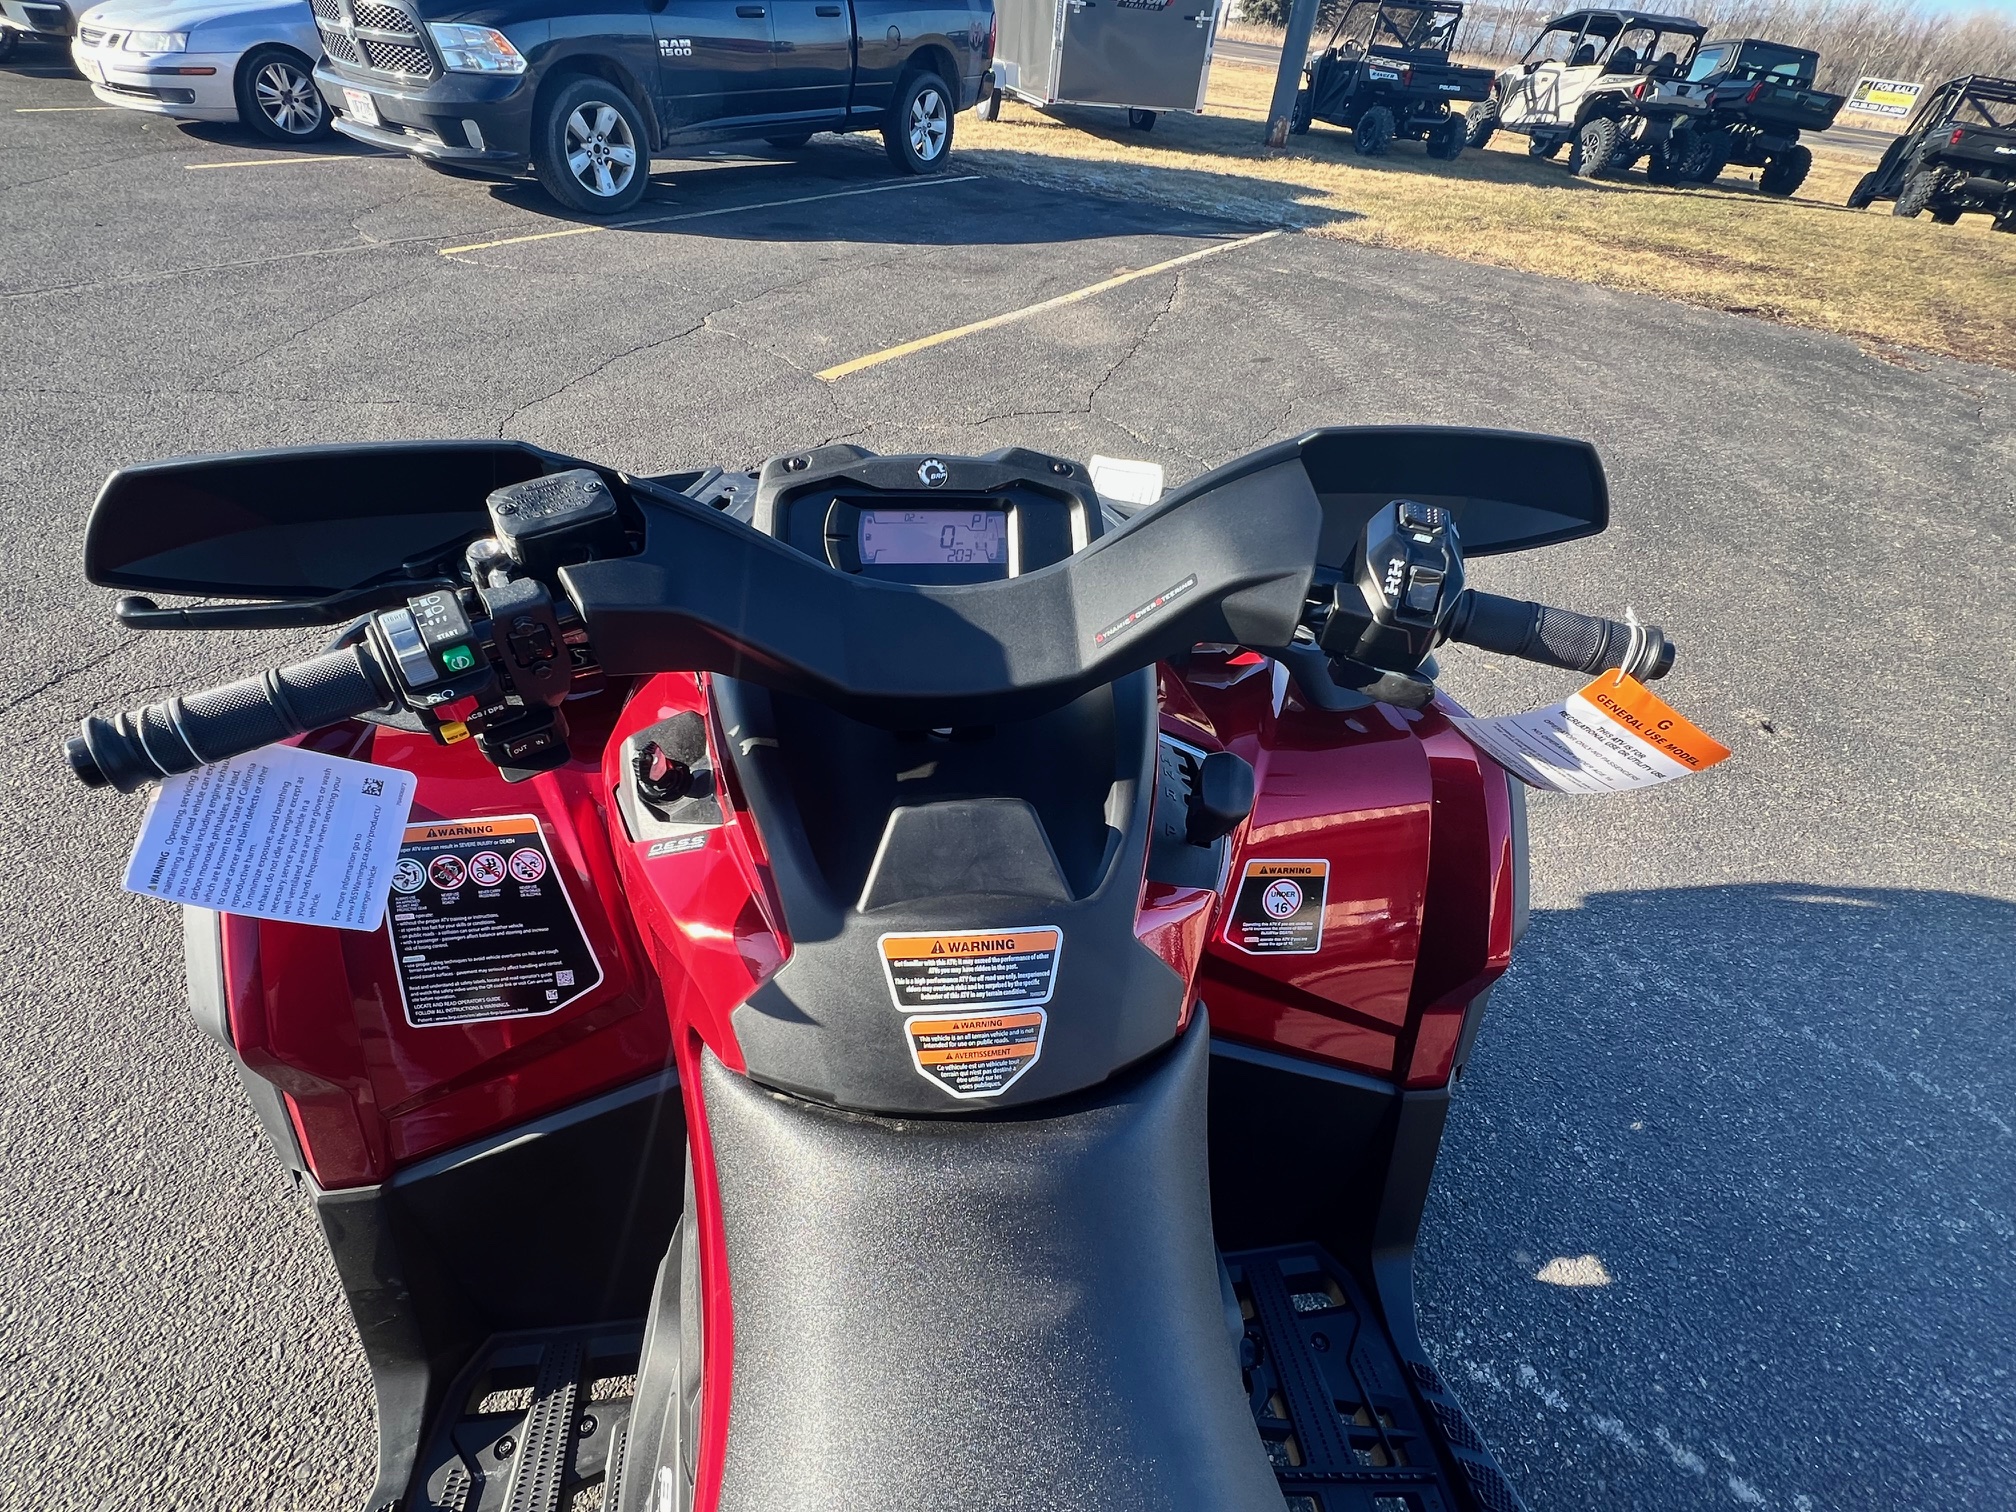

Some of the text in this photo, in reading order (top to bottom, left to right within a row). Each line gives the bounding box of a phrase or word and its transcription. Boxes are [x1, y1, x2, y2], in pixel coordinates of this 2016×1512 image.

[660, 48, 692, 56] 1500
[1875, 82, 1918, 94] FOR SALE
[428, 616, 447, 626] OFF
[437, 629, 458, 640] START
[467, 712, 482, 721] ACS
[488, 704, 504, 714] DPS
[1597, 694, 1699, 767] GENERAL USE MODEL
[1657, 720, 1673, 730] G
[514, 744, 527, 754] OUT
[1559, 711, 1606, 742] RECREATIONAL
[1605, 742, 1621, 751] USE
[1627, 755, 1652, 771] UTILITY
[1650, 769, 1667, 779] USE
[1597, 727, 1613, 738] THIS
[1612, 737, 1626, 746] ATV
[1631, 748, 1646, 759] FOR
[200, 776, 210, 790] can
[238, 762, 256, 795] California
[257, 765, 268, 785] other
[321, 767, 331, 785] wash
[254, 785, 262, 793] or
[272, 781, 291, 814] breathing
[289, 784, 302, 807] except
[319, 786, 326, 794] or
[191, 791, 205, 815] vehicle
[236, 795, 245, 804] of
[244, 794, 259, 819] defects
[312, 795, 324, 816] gloves
[164, 808, 186, 845] Operating,
[180, 775, 198, 807] servicing
[229, 805, 242, 822] State
[237, 820, 250, 837] birth
[268, 815, 279, 834] avoid
[282, 808, 294, 832] engine
[308, 817, 316, 834] wear
[180, 816, 196, 845] off-road
[190, 770, 241, 900] carbon monoxide, phthalates, and lead,
[225, 824, 236, 835] the
[437, 823, 493, 838] WARNING
[176, 885, 186, 897] you
[183, 843, 201, 876] chemicals
[195, 809, 215, 841] including
[208, 783, 222, 808] engine
[234, 838, 245, 852] and
[276, 833, 287, 844] the
[280, 854, 293, 878] service
[288, 837, 298, 853] your
[293, 813, 306, 836] vehicle
[295, 776, 341, 916] your hands frequently when servicing your
[302, 834, 312, 848] and
[352, 841, 360, 850] go
[177, 846, 186, 855] an
[213, 845, 228, 869] known
[257, 835, 274, 867] exposure,
[272, 845, 283, 858] idle
[298, 849, 307, 864] area
[227, 853, 239, 876] cancer
[269, 859, 279, 871] not
[340, 852, 356, 890] information
[162, 856, 184, 894] maintaining
[211, 870, 220, 882] are
[230, 843, 257, 907] reproductive harm.
[265, 872, 274, 882] do
[203, 882, 216, 902] which
[220, 877, 232, 896] cause
[247, 868, 262, 900] minimize
[257, 883, 272, 911] exhaust,
[308, 893, 320, 917] vehicle.
[336, 891, 346, 908] more
[330, 909, 340, 920] For
[1274, 903, 1288, 913] 16
[948, 939, 1015, 953] WARNING
[961, 1019, 1002, 1029] WARNING
[955, 1048, 1011, 1059] AVERTISSEMENT
